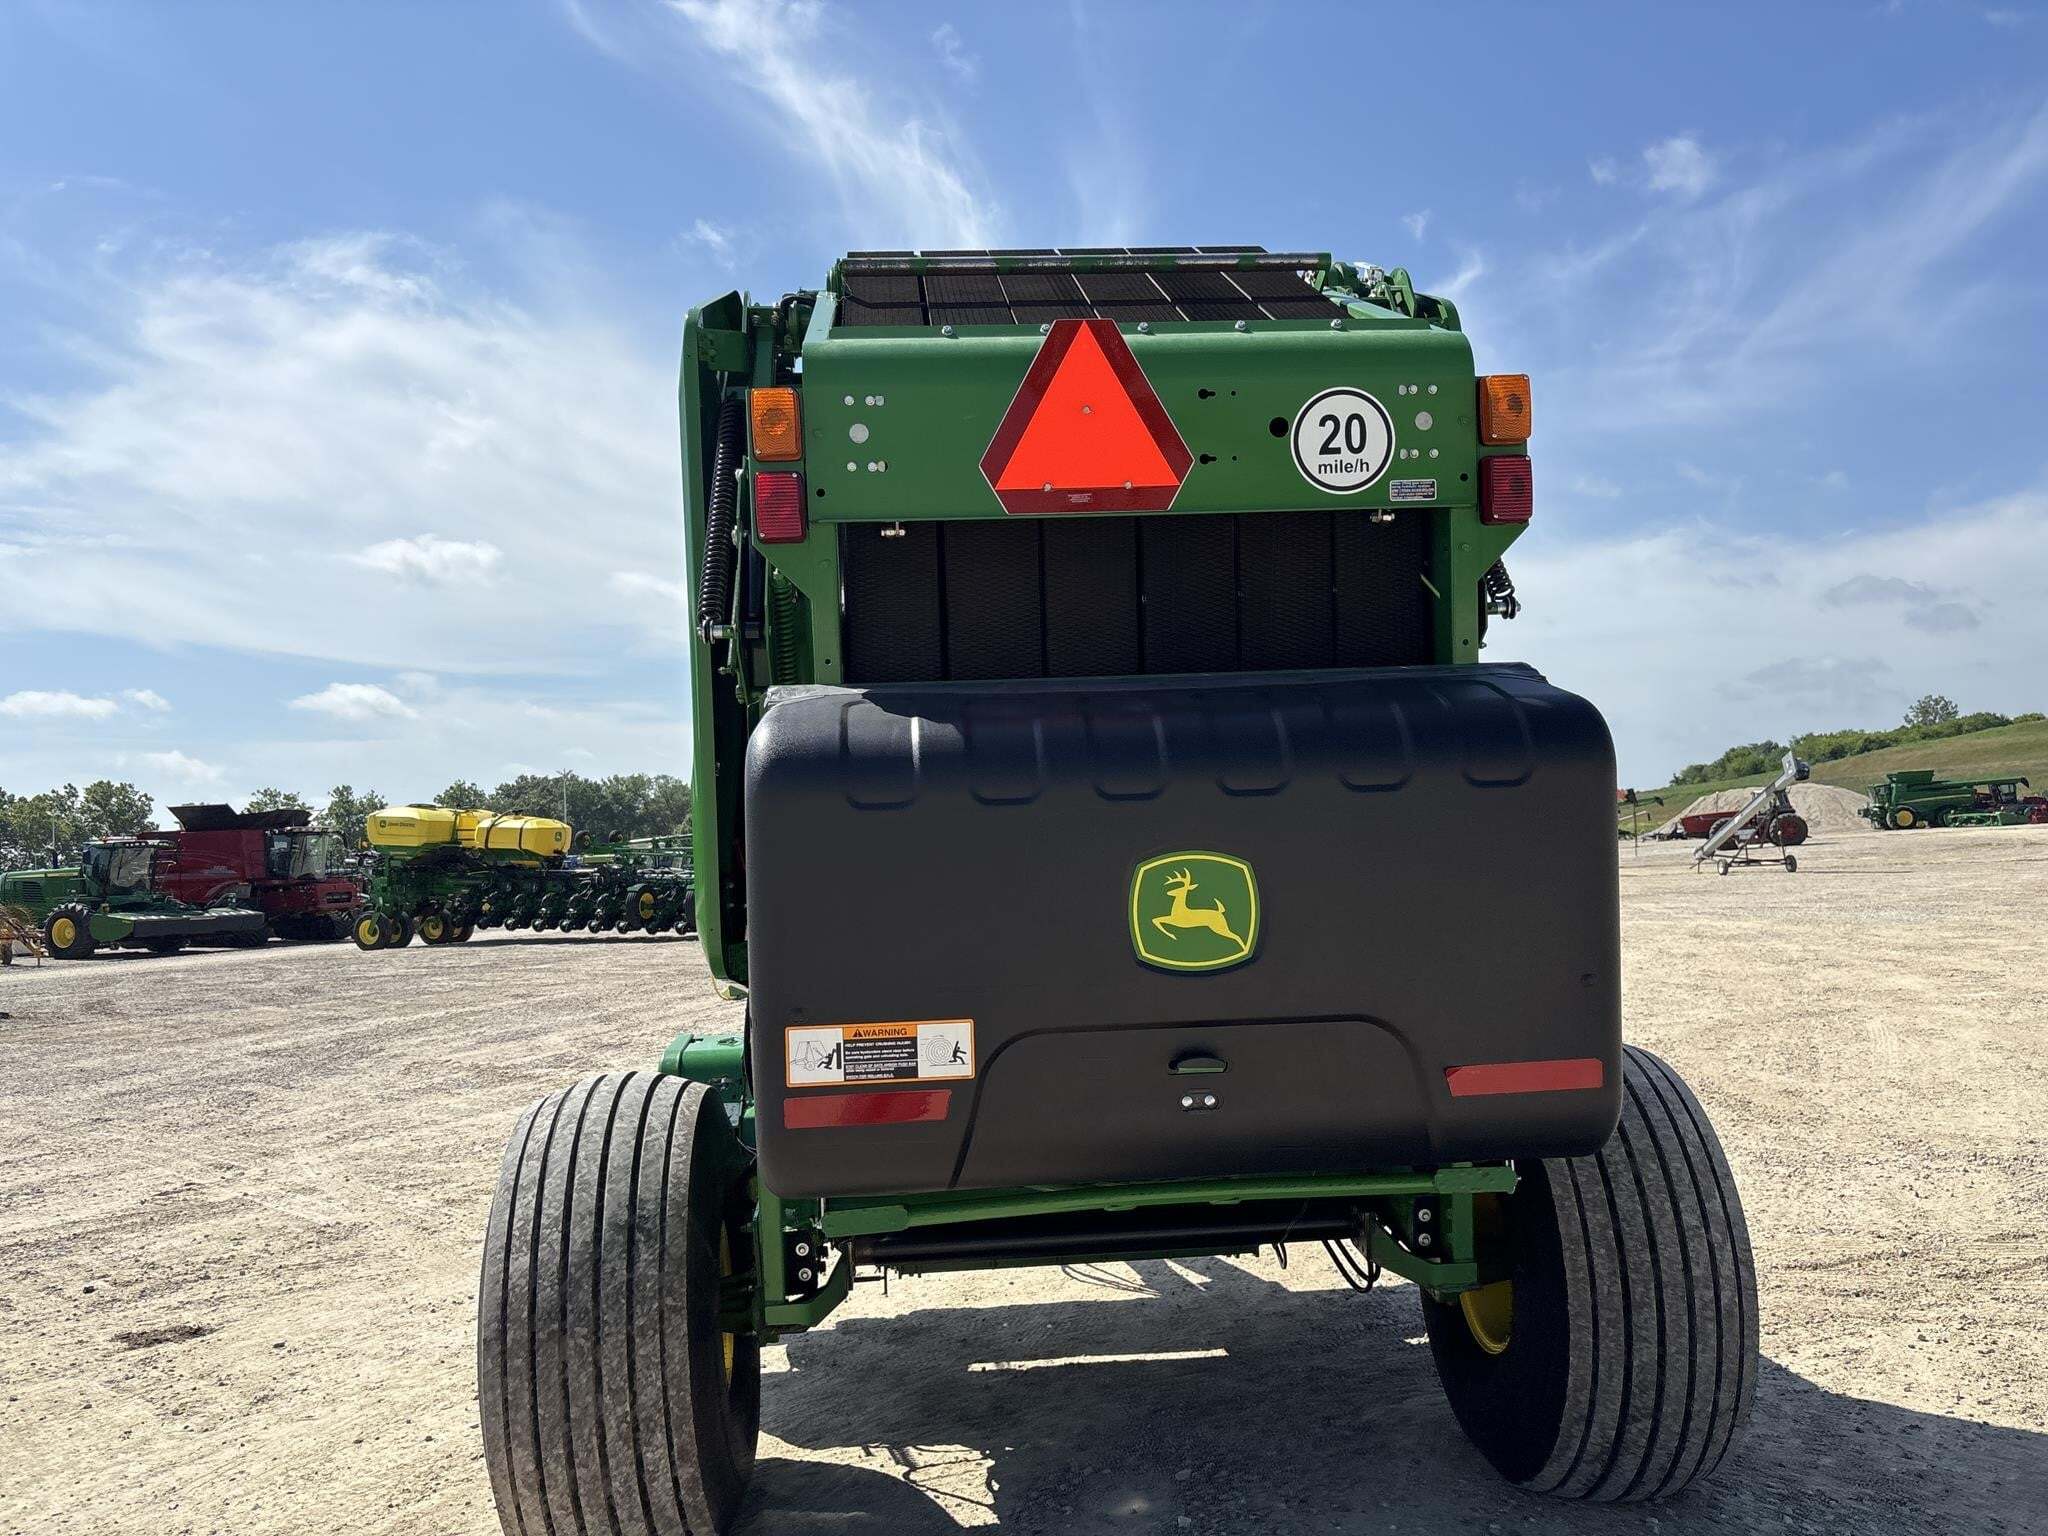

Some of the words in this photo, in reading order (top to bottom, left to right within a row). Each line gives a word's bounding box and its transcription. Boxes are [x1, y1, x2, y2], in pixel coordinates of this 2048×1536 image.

[1318, 413, 1367, 455] 20
[1318, 458, 1370, 474] mile/h
[863, 1028, 907, 1037] WARNING
